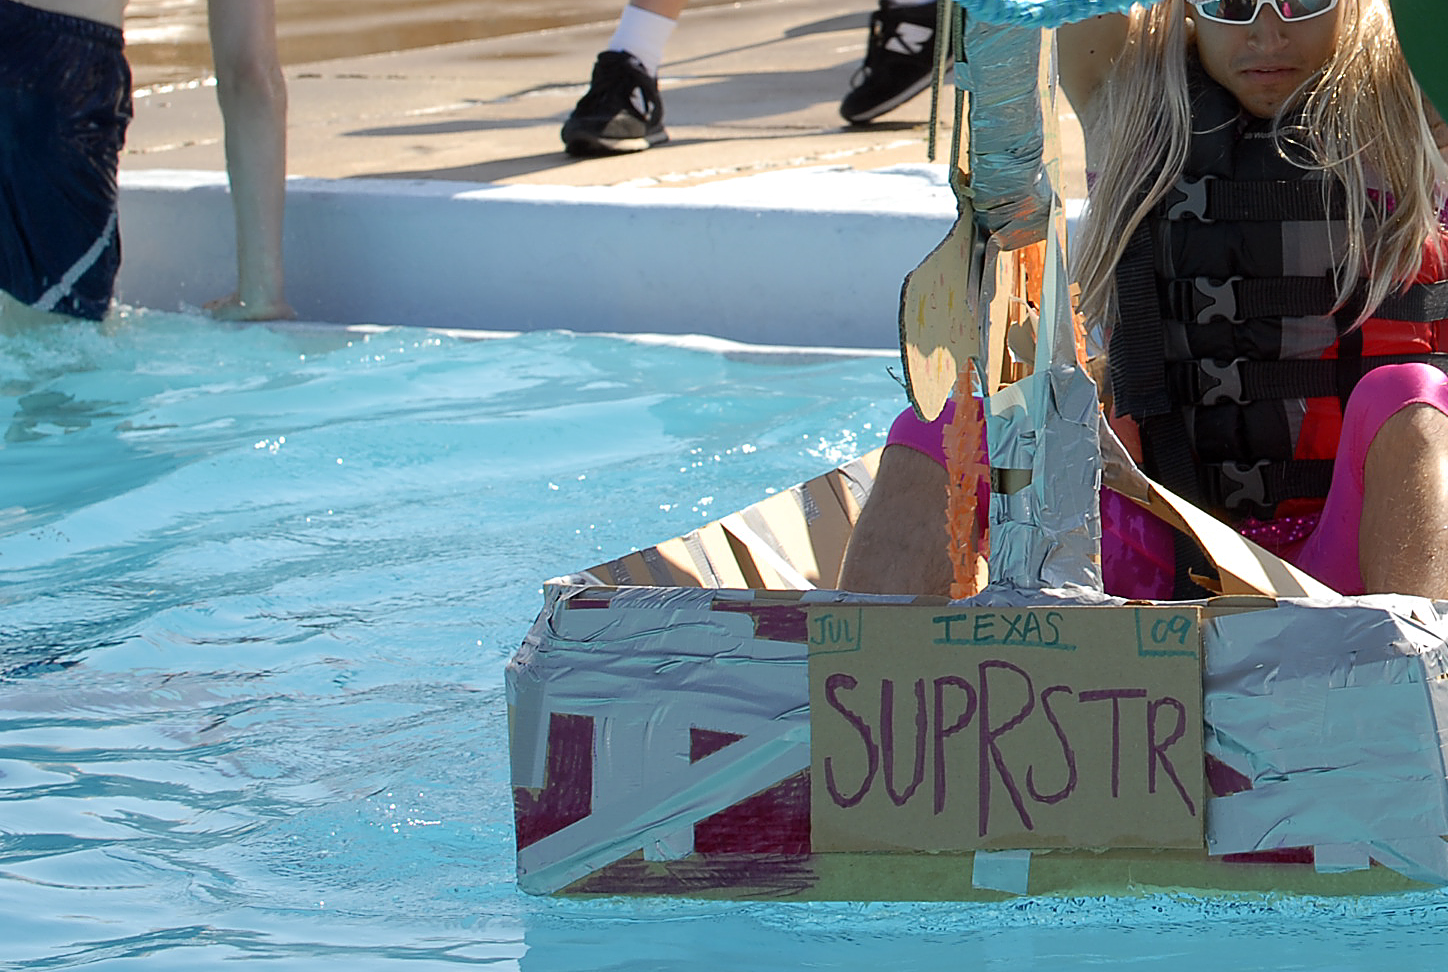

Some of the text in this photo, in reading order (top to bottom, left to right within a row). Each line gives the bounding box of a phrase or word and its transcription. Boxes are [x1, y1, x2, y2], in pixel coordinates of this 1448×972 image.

[810, 616, 854, 646] JUL
[932, 612, 1066, 646] TEXAS
[1150, 617, 1193, 645] 09
[824, 660, 1196, 837] SUPRSTR
